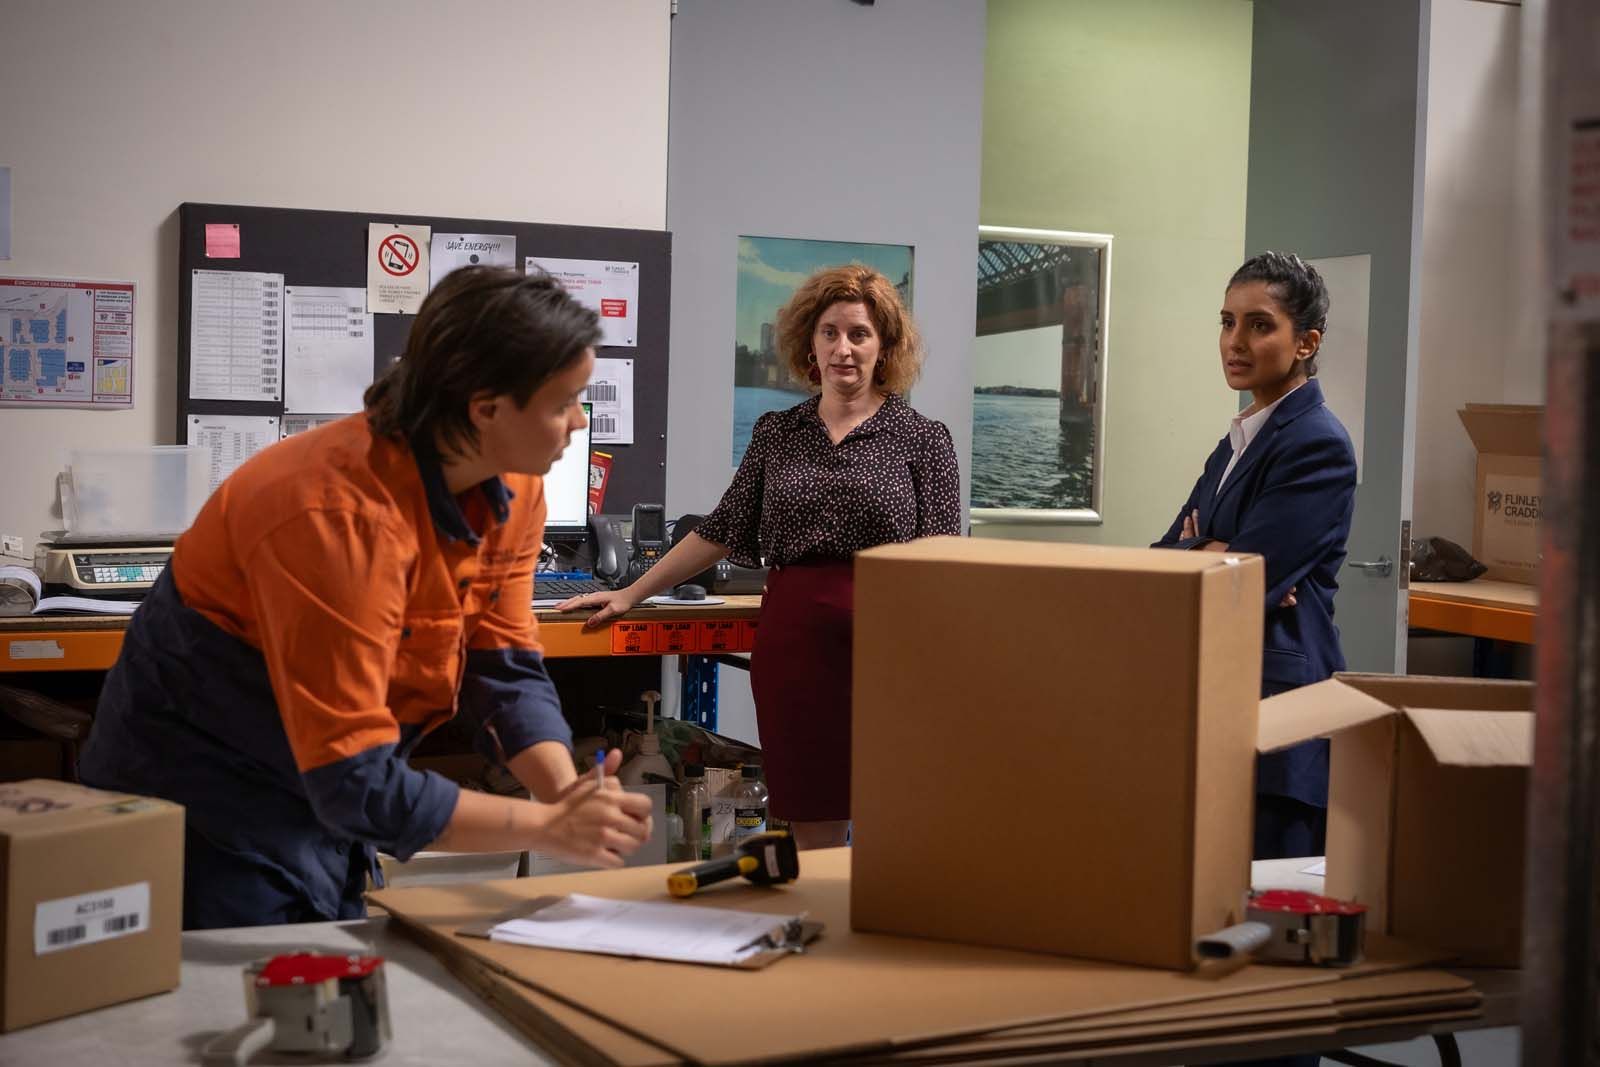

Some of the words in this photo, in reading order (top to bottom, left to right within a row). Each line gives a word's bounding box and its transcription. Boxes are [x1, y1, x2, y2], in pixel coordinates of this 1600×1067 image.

[446, 242, 462, 250] SAVE
[464, 242, 501, 254] ENERGY!!!
[619, 624, 631, 632] TOP
[632, 624, 648, 632] LOAD
